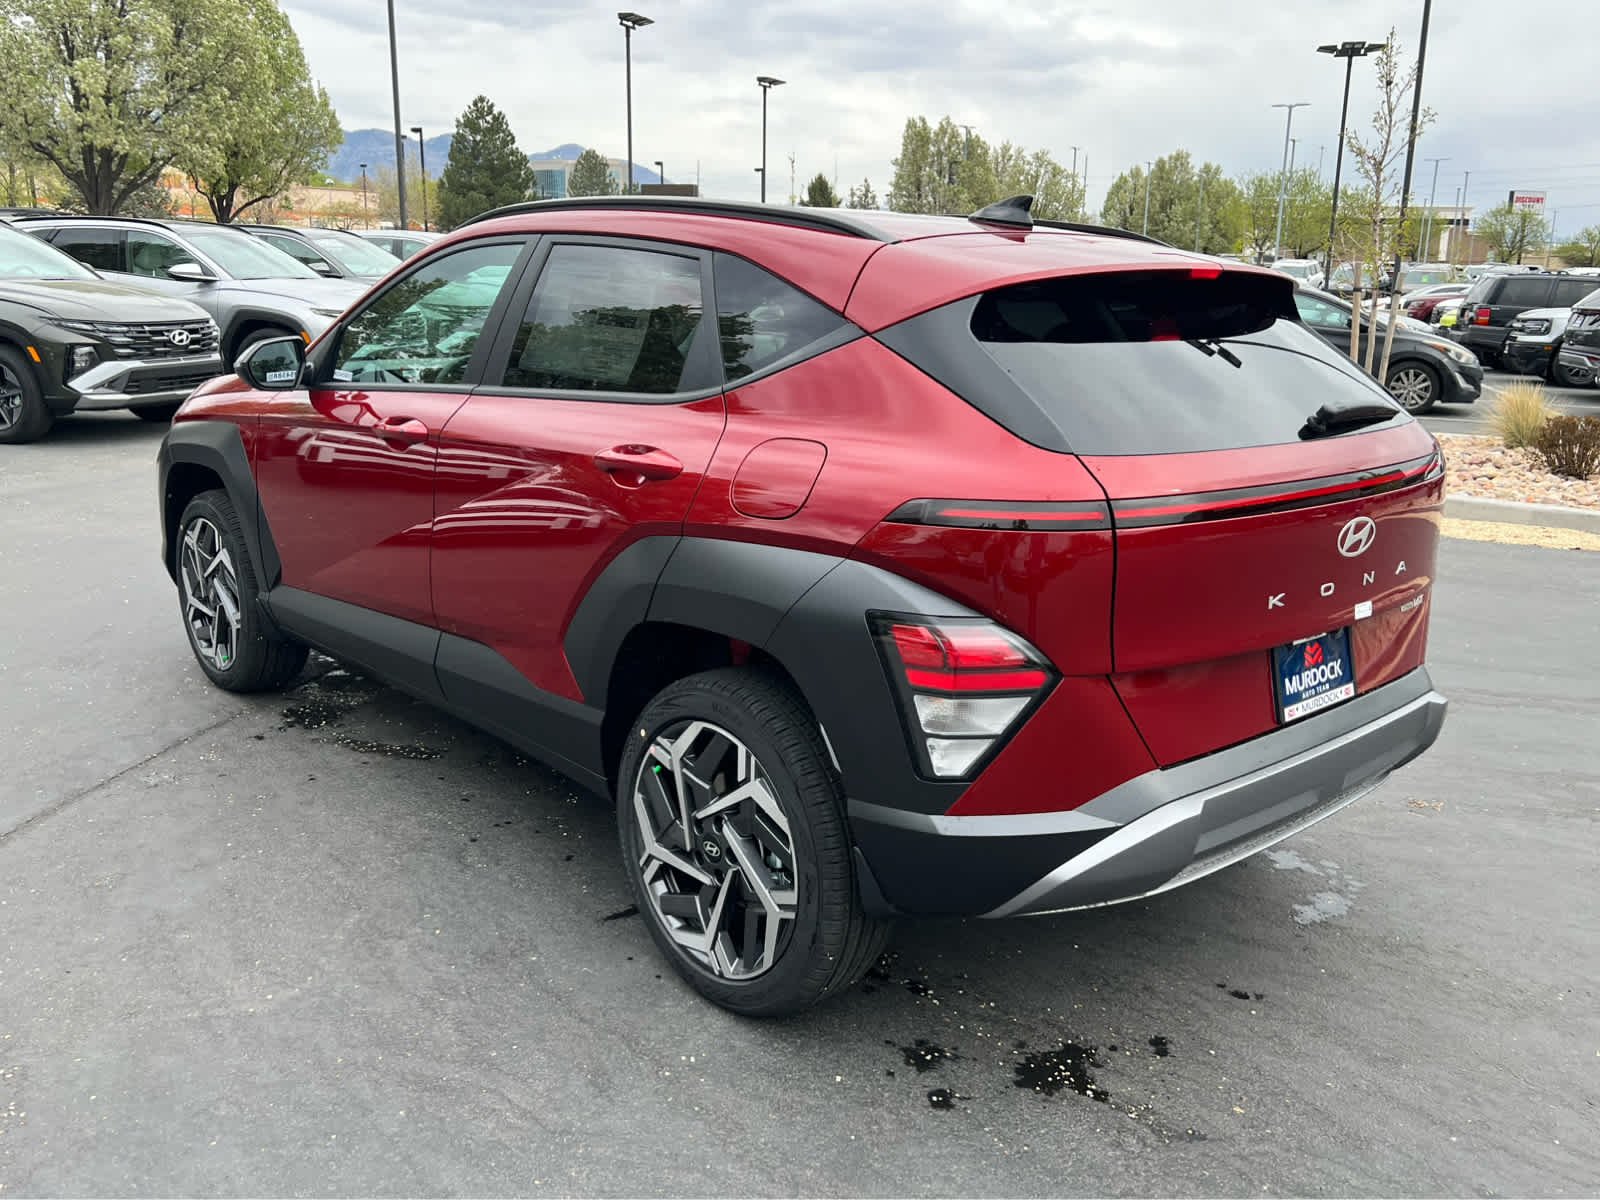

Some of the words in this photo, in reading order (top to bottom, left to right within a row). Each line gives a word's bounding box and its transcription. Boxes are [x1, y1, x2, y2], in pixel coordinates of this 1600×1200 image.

[1268, 560, 1407, 610] KONA
[1284, 658, 1343, 695] MURDOCK
[1302, 689, 1316, 699] AUTO
[1317, 683, 1330, 693] TEAM
[1301, 691, 1340, 712] MURDOCK
